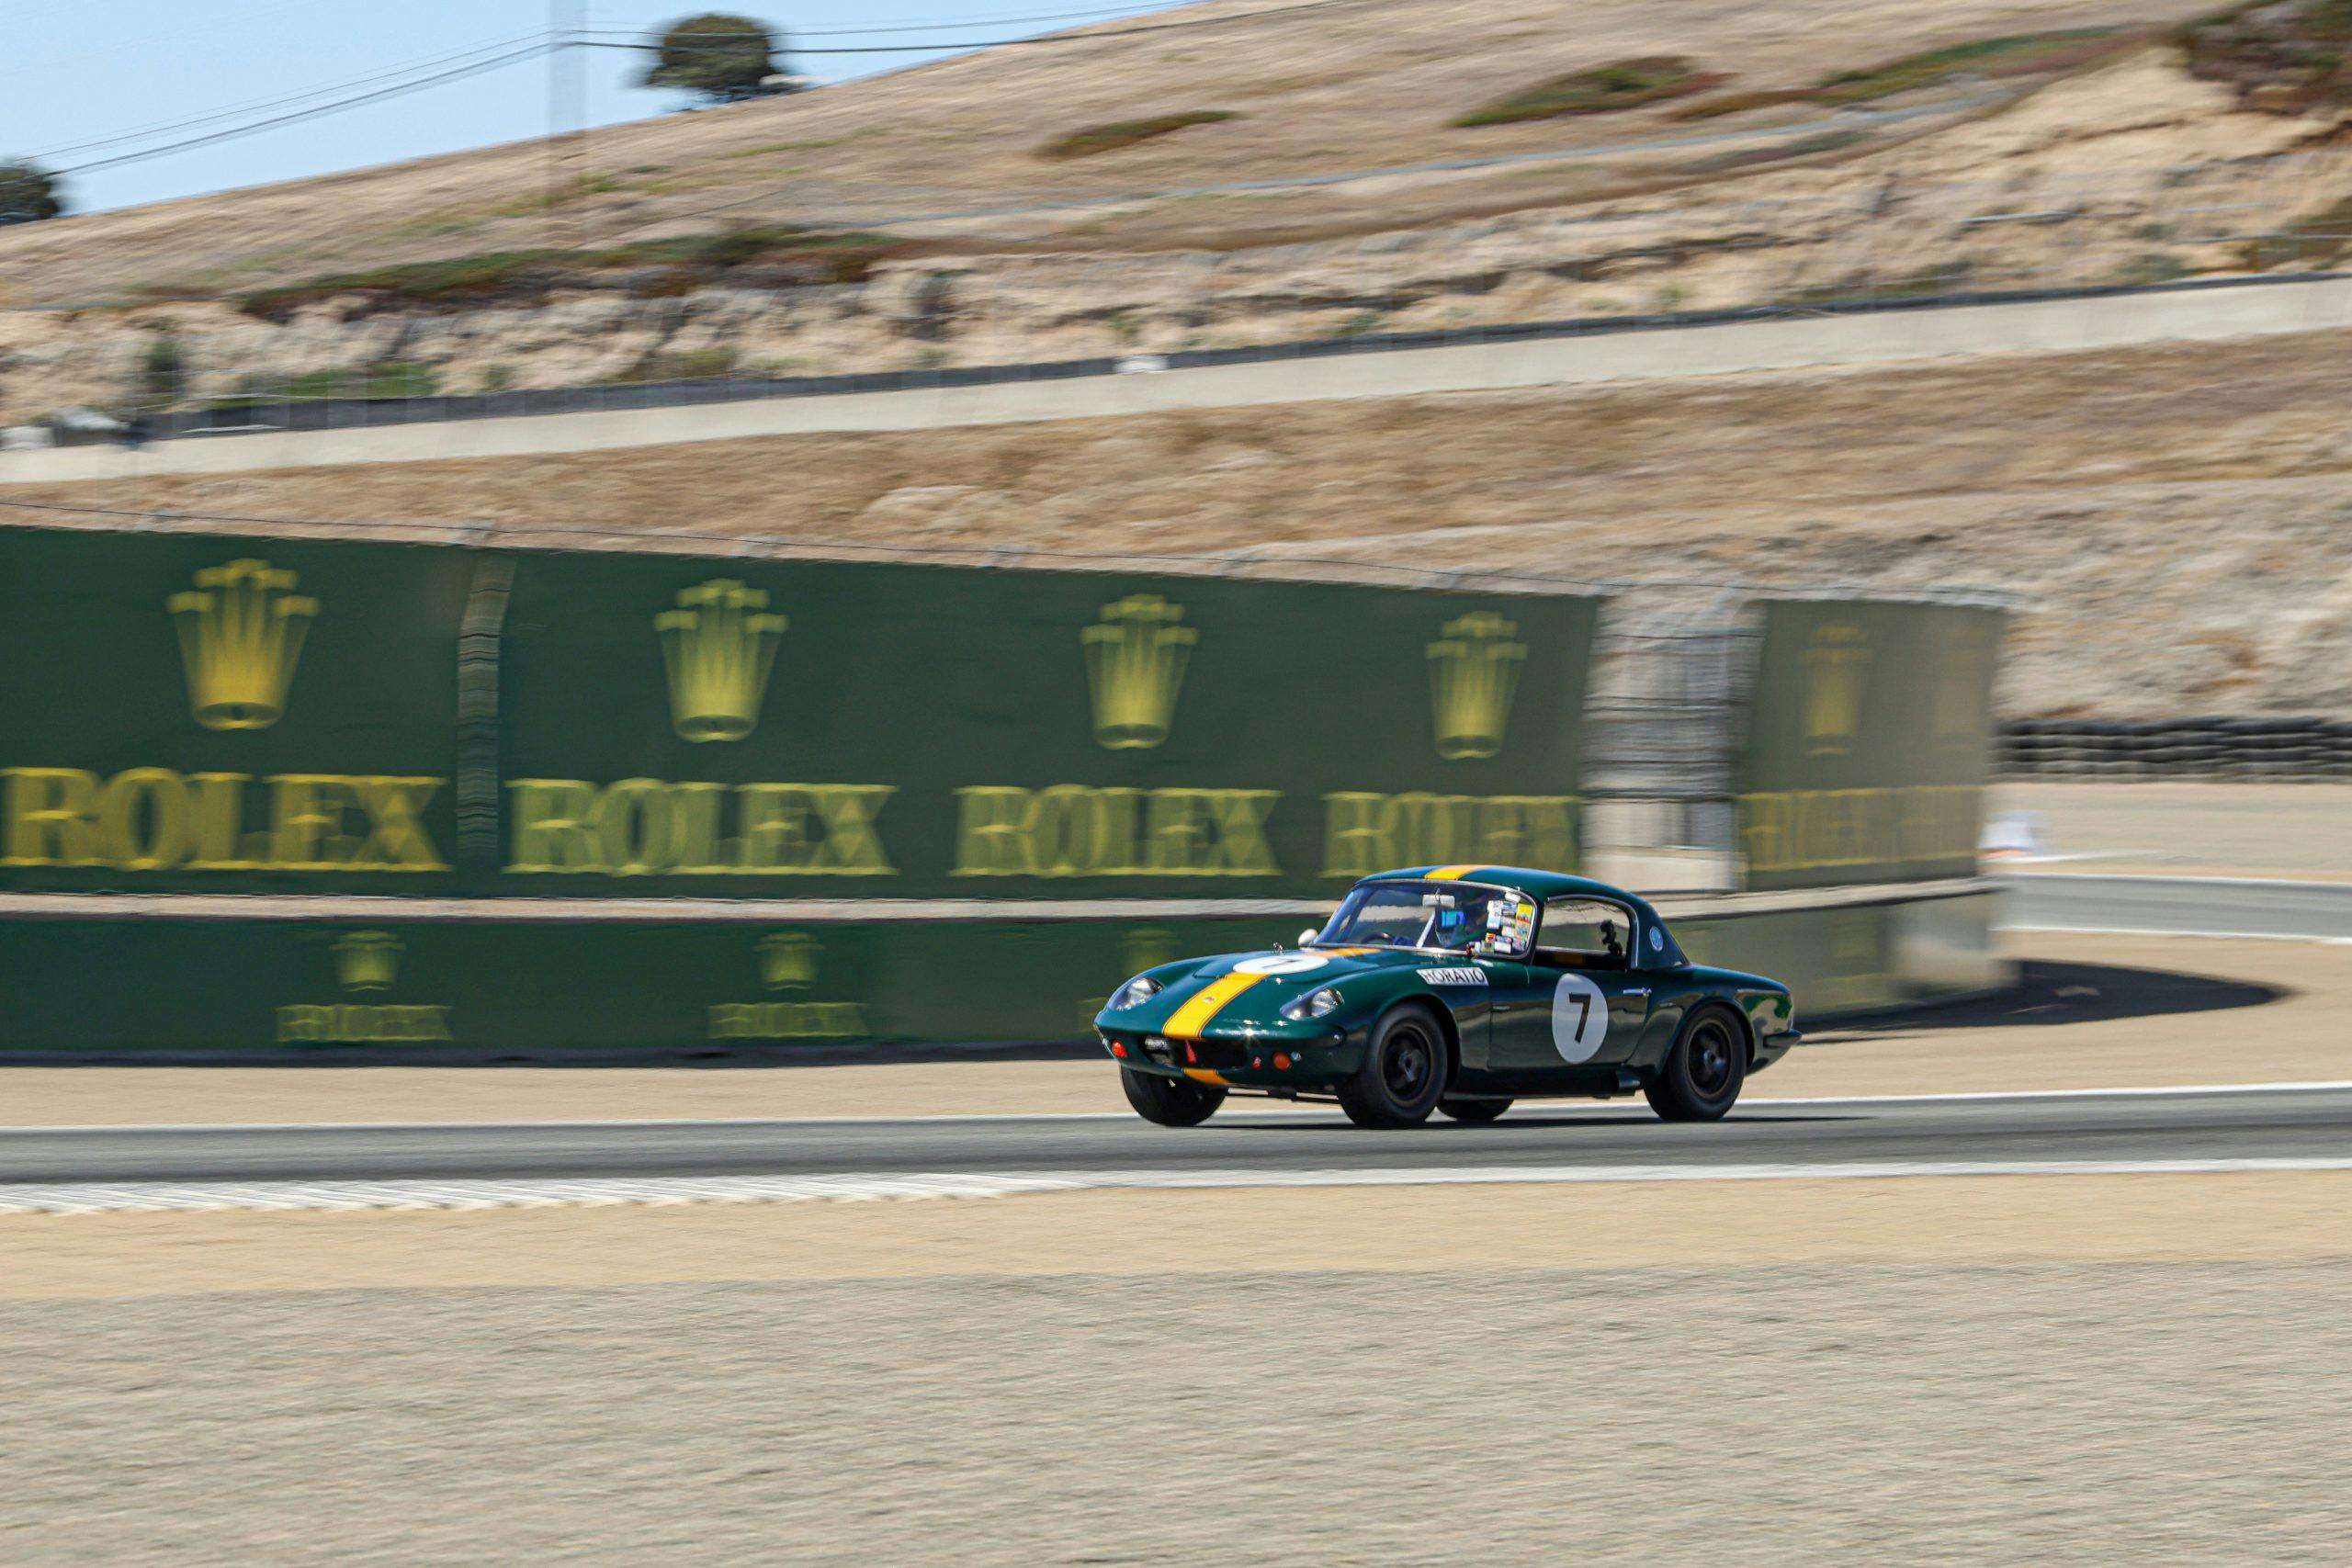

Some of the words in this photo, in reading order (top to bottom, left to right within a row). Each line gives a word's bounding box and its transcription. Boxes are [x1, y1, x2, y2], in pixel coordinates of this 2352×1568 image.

[0, 766, 455, 872] ROLEX
[501, 777, 900, 876] ROLEX
[1419, 968, 1486, 984] HORATIO
[1569, 993, 1591, 1043] 7
